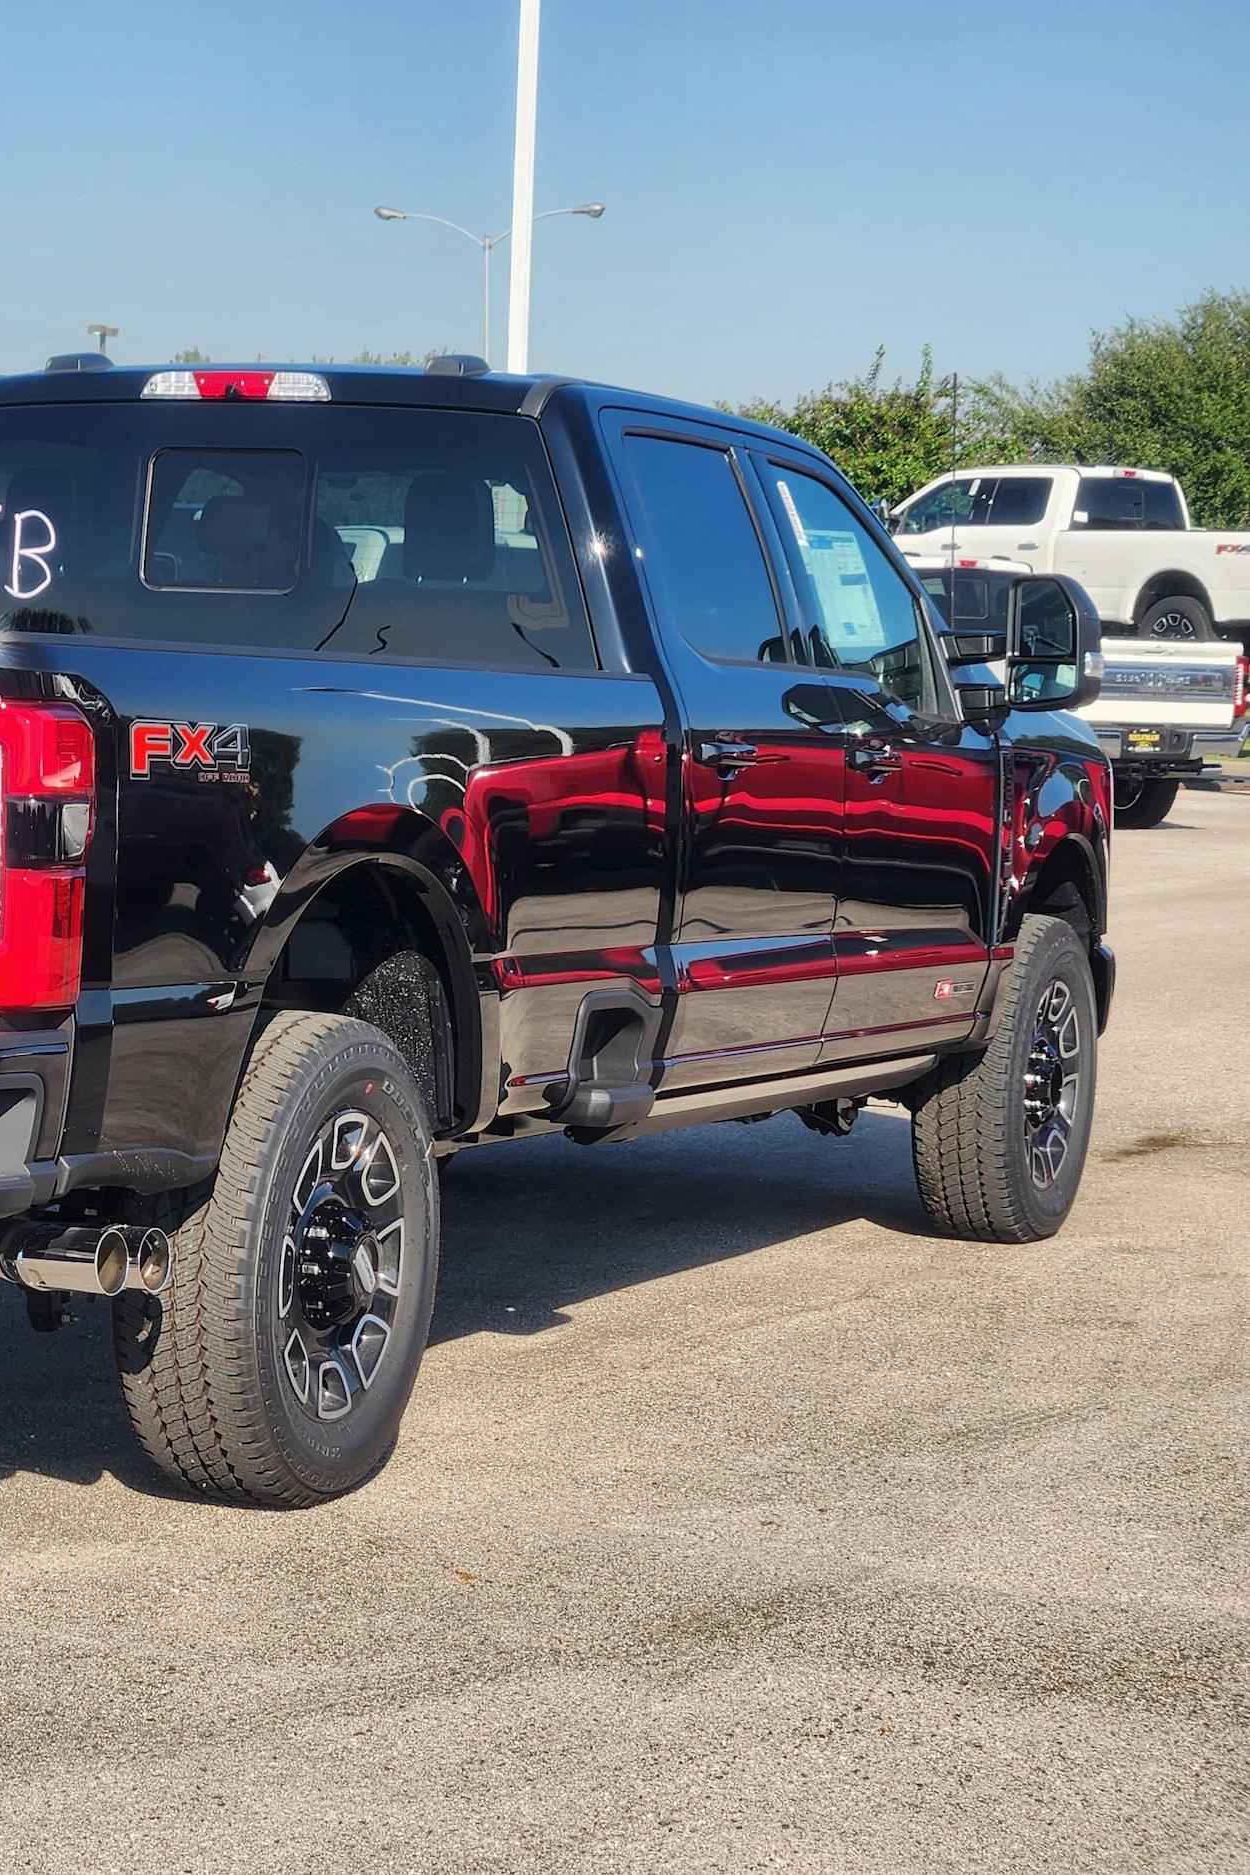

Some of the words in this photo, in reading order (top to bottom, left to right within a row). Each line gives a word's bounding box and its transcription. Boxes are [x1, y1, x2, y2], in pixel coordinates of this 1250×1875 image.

[130, 719, 251, 780] FX4
[198, 772, 220, 782] OFF
[222, 773, 250, 783] ROAD
